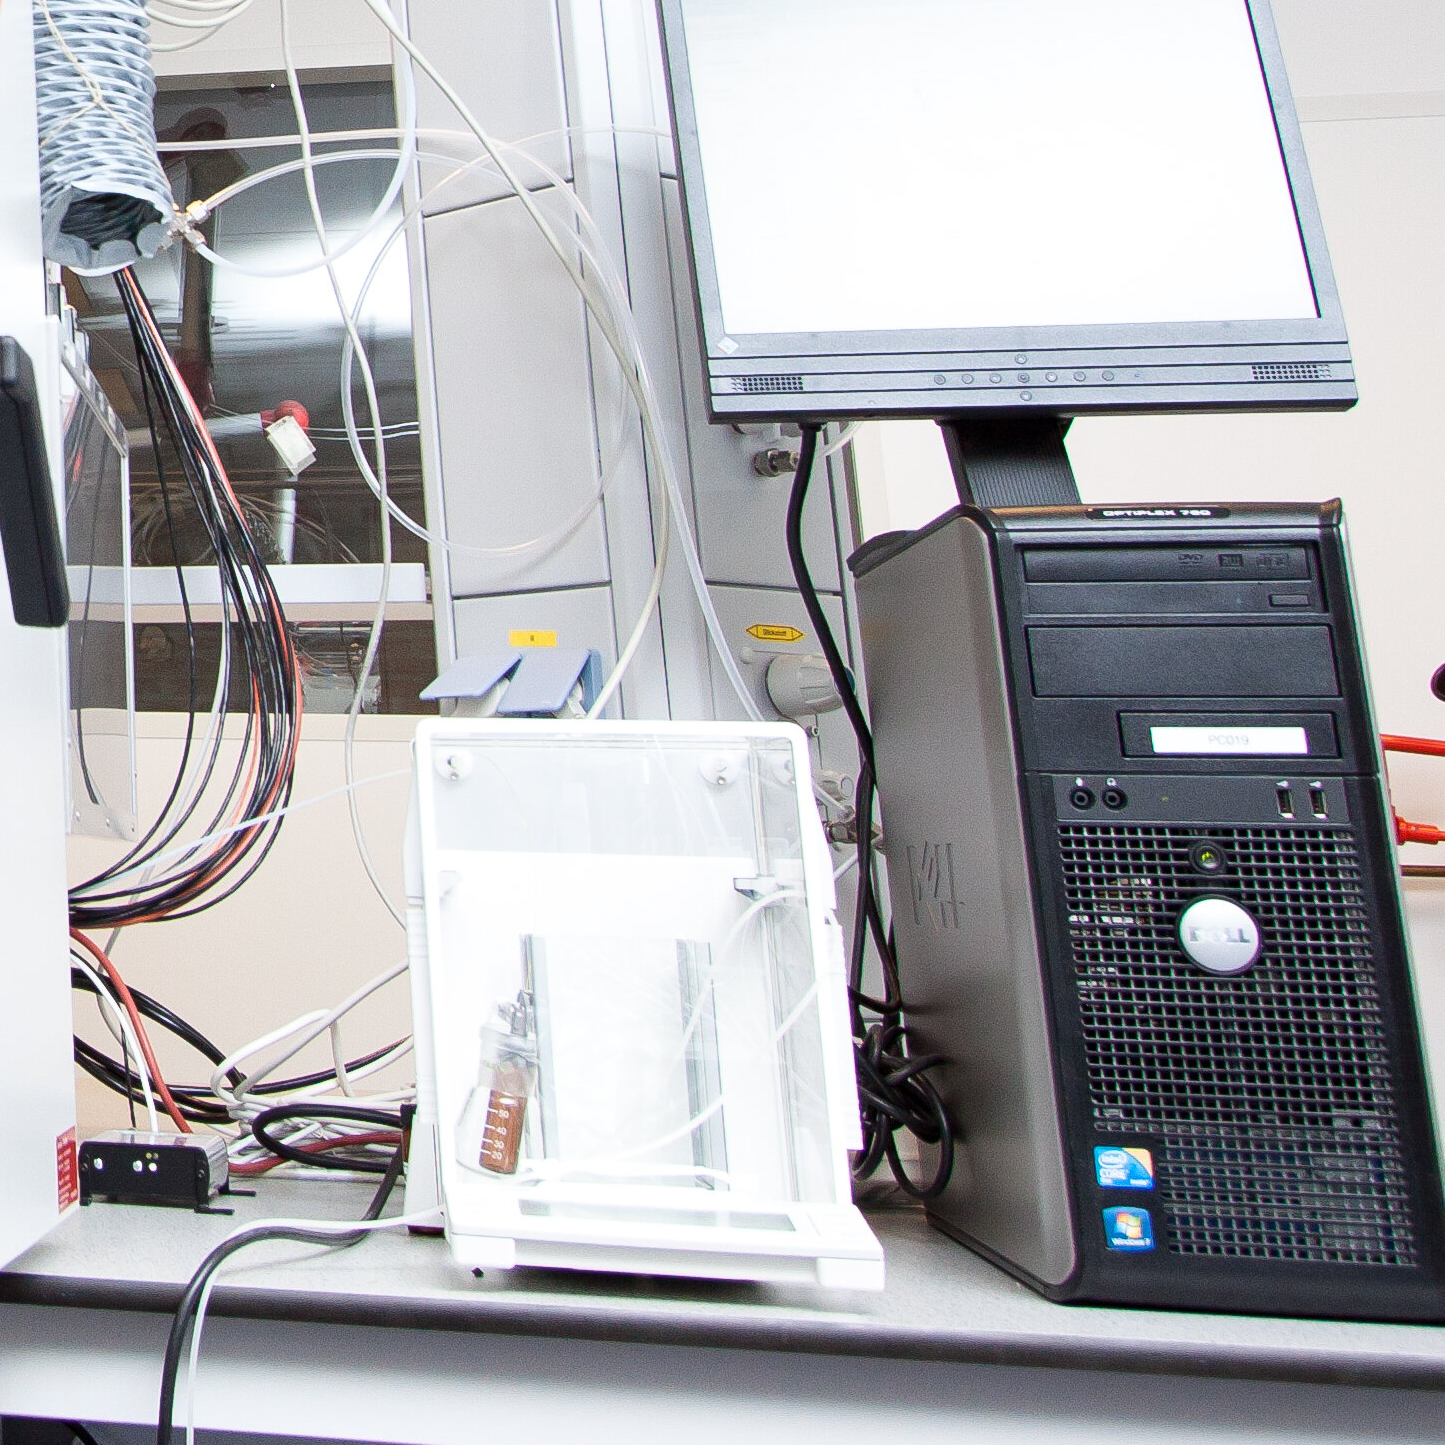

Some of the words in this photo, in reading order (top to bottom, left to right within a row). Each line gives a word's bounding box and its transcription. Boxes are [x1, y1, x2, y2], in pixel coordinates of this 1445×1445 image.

[1102, 509, 1177, 517] OPTIPLEX
[1208, 735, 1249, 746] PC019
[498, 1109, 509, 1119] 50
[496, 1126, 507, 1136] 40
[493, 1140, 504, 1149] 30
[491, 1150, 503, 1160] 20
